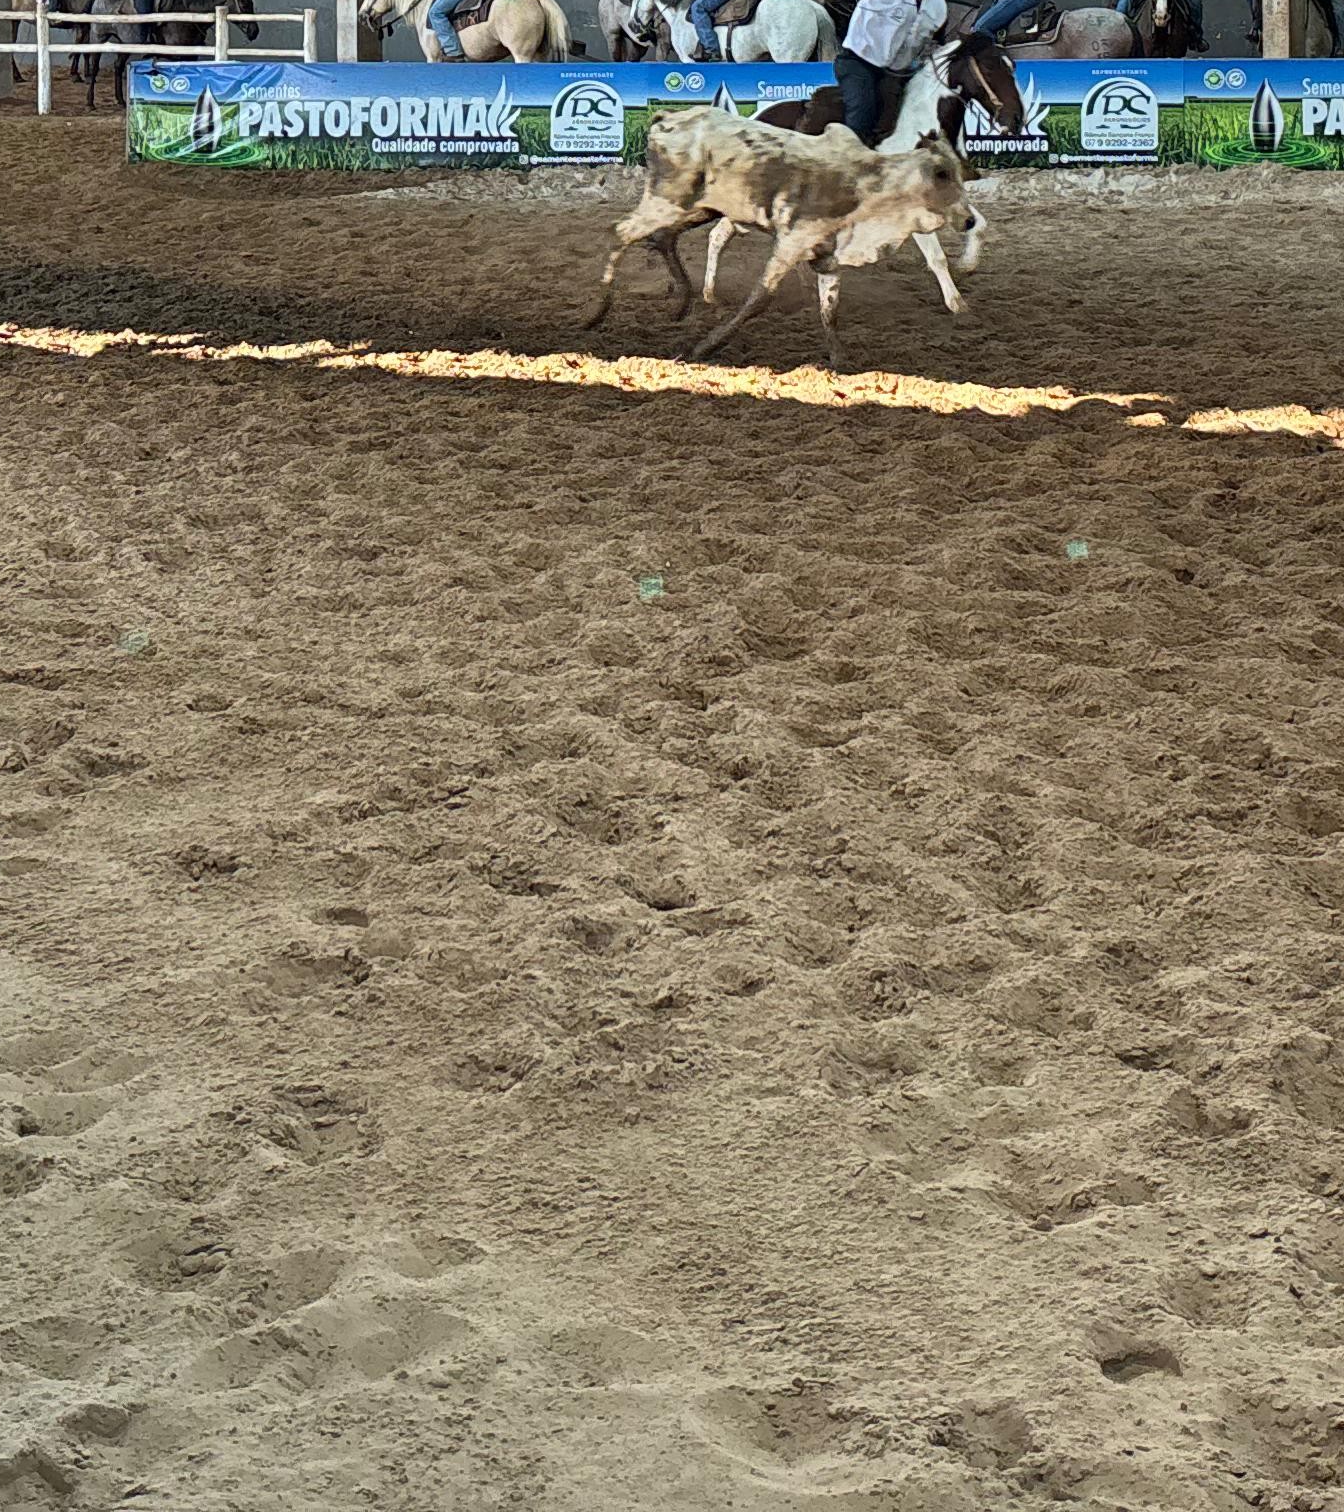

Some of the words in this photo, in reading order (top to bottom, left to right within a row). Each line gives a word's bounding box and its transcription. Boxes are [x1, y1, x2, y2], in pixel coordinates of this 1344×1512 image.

[240, 83, 301, 99] Sementes
[239, 96, 488, 138] PASTOFORMA
[371, 137, 436, 154] Qualidade
[439, 137, 520, 155] comprovada
[965, 137, 1049, 155] comprovada
